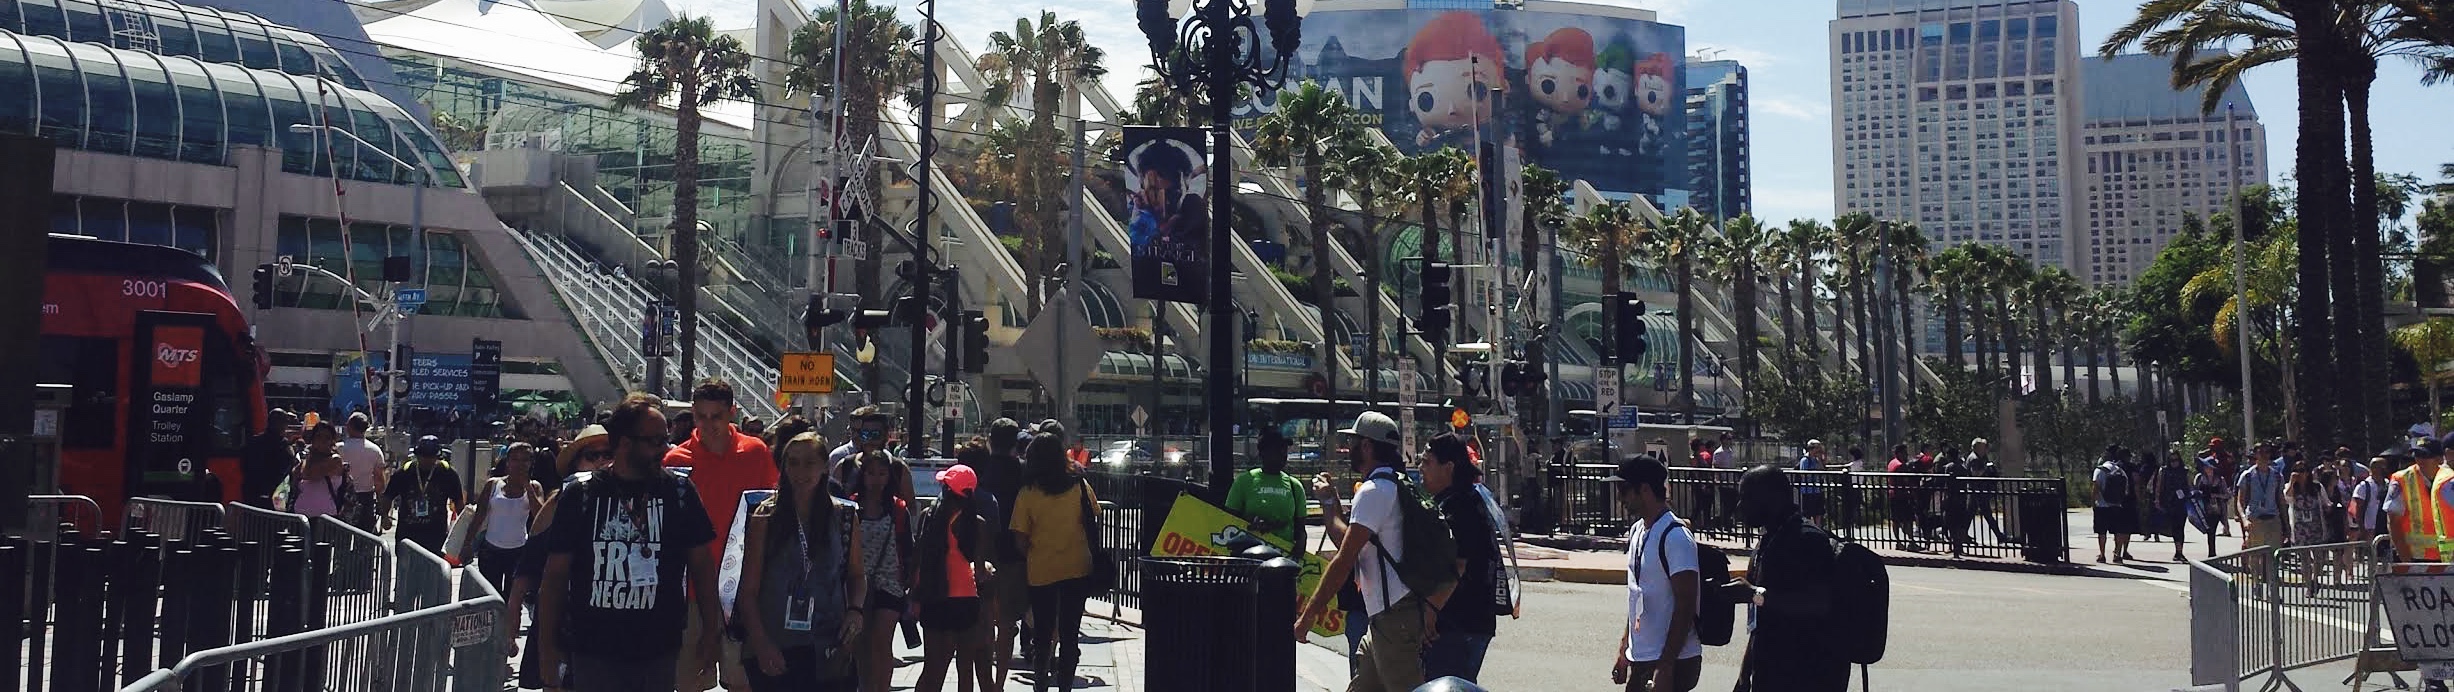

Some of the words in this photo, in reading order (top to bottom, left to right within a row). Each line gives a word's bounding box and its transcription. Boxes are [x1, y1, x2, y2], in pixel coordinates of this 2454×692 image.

[844, 241, 866, 259] TRACKS
[122, 280, 166, 299] 3001
[157, 343, 199, 367] MTS
[800, 360, 815, 371] NO
[432, 368, 469, 377] SERVICES
[1599, 370, 1616, 379] STOP
[784, 375, 805, 386] TRAIN
[809, 375, 831, 386] HORN
[153, 391, 194, 404] Gaslamp
[1601, 388, 1615, 397] RED
[152, 404, 188, 414] Quarter
[152, 420, 181, 432] Trolley
[150, 433, 183, 443] Station
[593, 541, 661, 581] FRE
[589, 580, 657, 610] NEGAN
